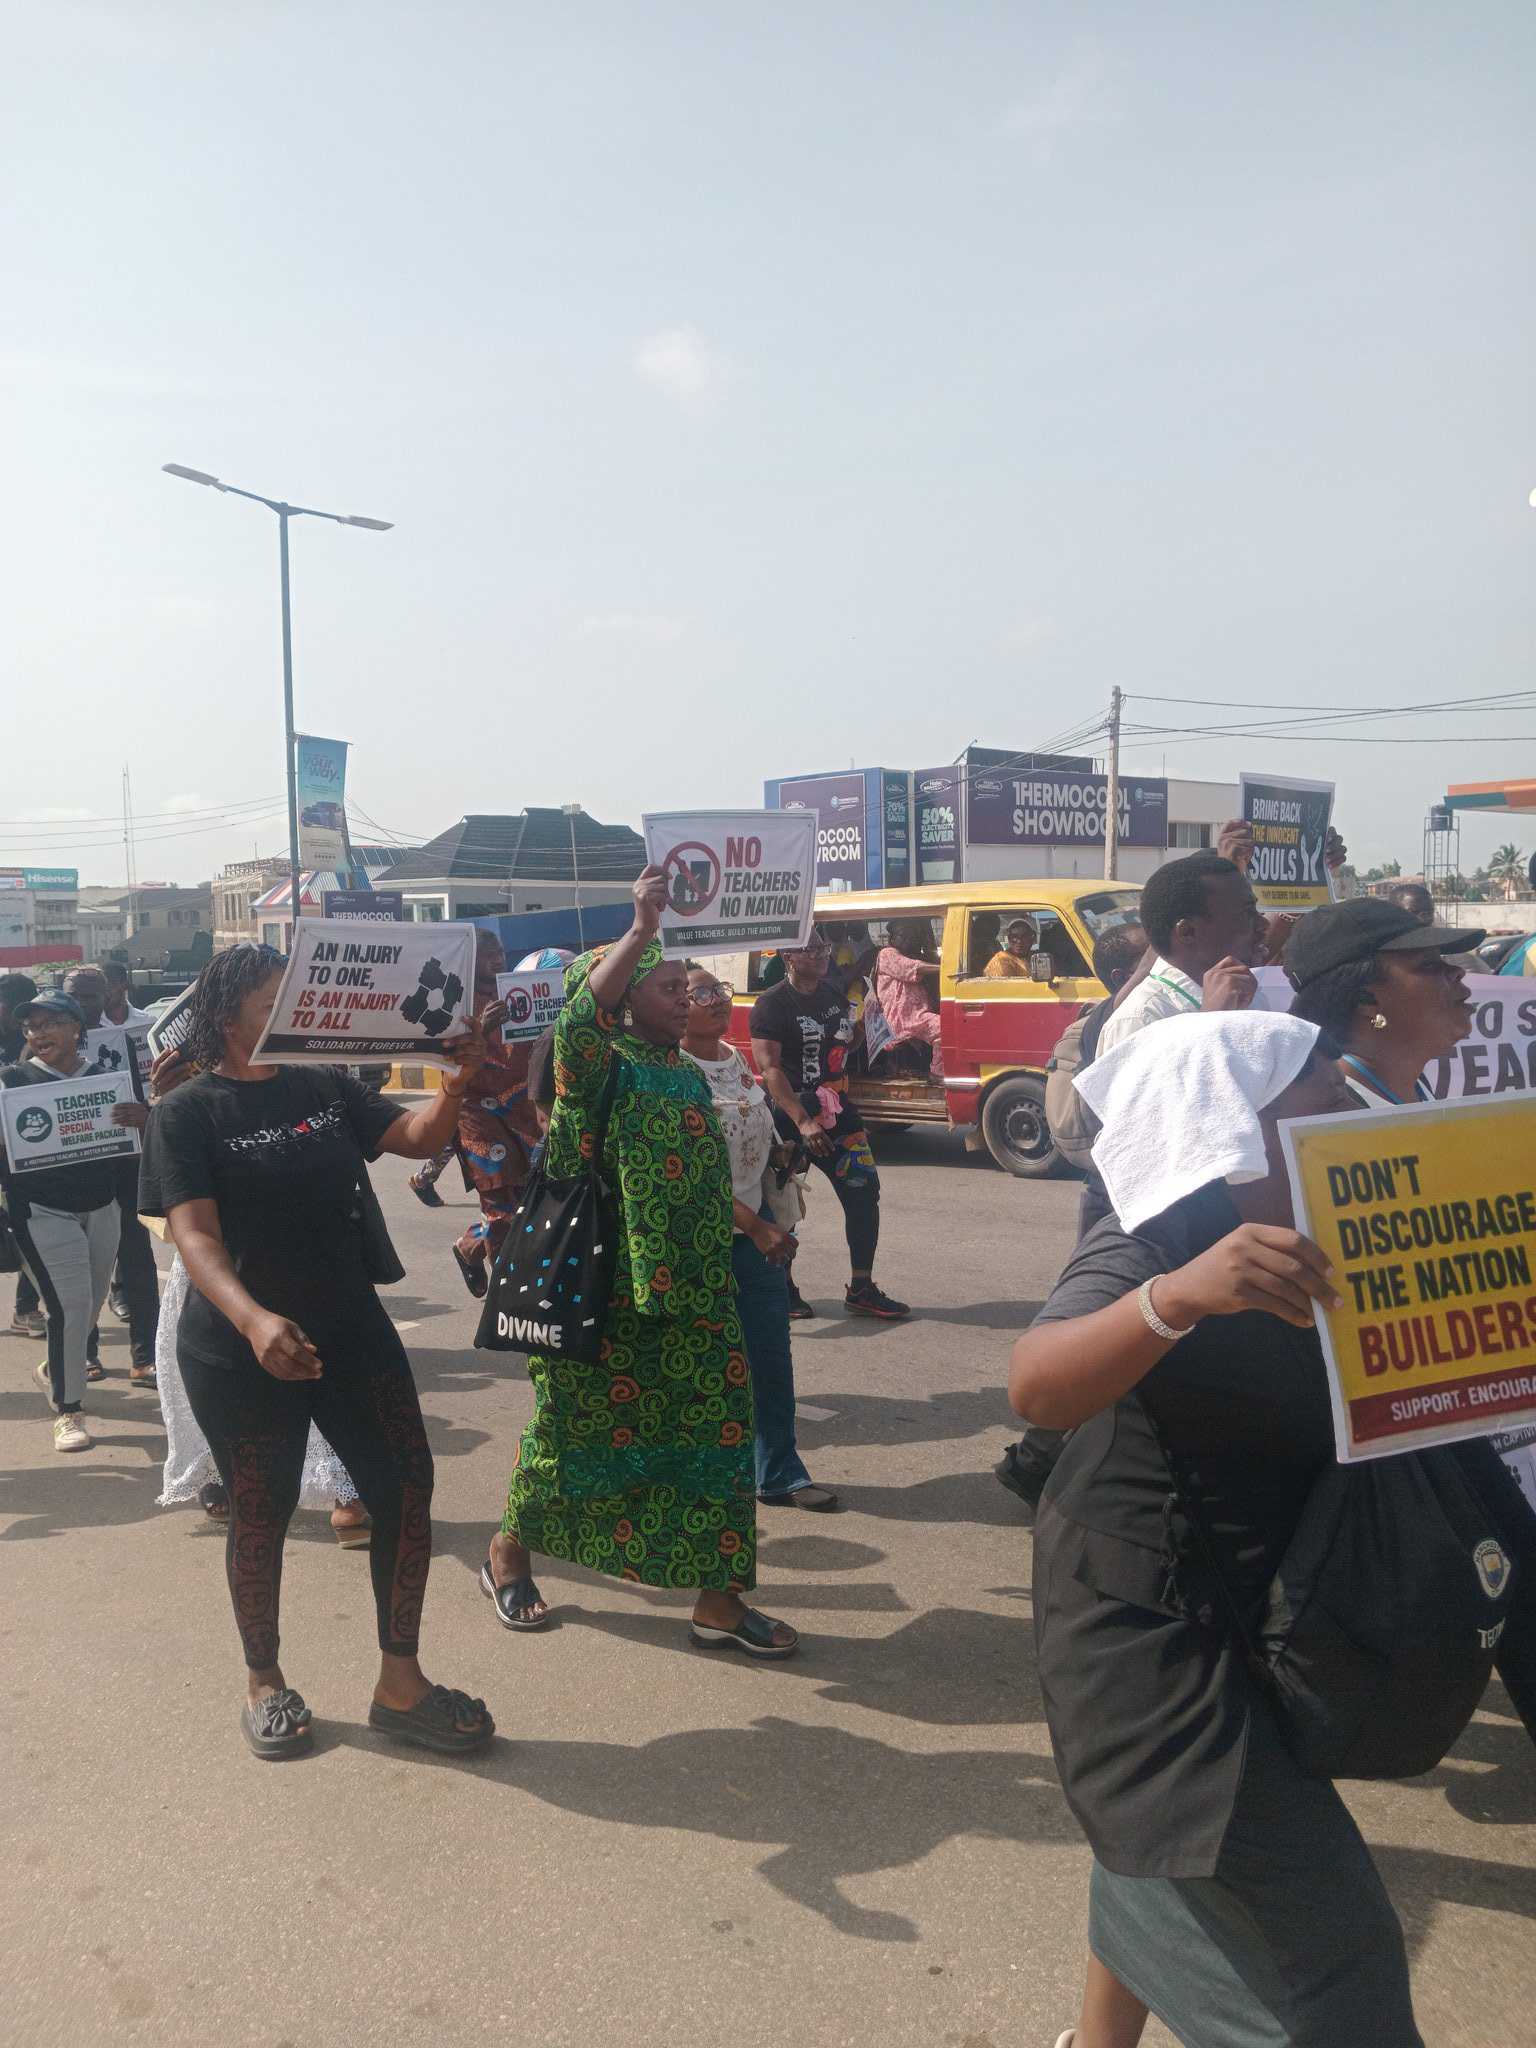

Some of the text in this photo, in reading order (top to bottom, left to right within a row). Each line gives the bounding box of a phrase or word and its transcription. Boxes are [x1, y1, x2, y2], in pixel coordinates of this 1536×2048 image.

[922, 807, 954, 825] 50%
[1253, 798, 1302, 823] BRING BACK
[922, 830, 954, 843] SAVER
[1252, 824, 1299, 844] THE INNOCENT
[725, 836, 761, 868] NO
[1249, 846, 1297, 881] SOULS
[724, 871, 800, 893] TEACHERS
[332, 911, 396, 920] THERMOCOOL
[720, 894, 799, 918] NO NATION
[677, 931, 693, 940] VALUE
[748, 926, 757, 935] THE
[312, 943, 402, 964] AN INJURY
[308, 966, 375, 990] TO ONE,
[297, 990, 401, 1011] IS AN INJURY
[532, 983, 550, 998] NO
[290, 1010, 352, 1029] TO ALL
[535, 1012, 546, 1023] NO
[305, 1040, 367, 1051] SOLIDARITY
[54, 1090, 117, 1112] TEACHERS
[57, 1107, 102, 1124] DESERVE
[59, 1121, 94, 1136] SPECIAL
[61, 1128, 127, 1147] WELFARE PACKAGE
[1327, 1155, 1421, 1208] DON'T
[1337, 1191, 1536, 1261] DISCOURAGE
[1346, 1245, 1532, 1313] THE NATION
[497, 1312, 562, 1349] DIVINE
[1391, 1387, 1466, 1422] SUPPORT.
